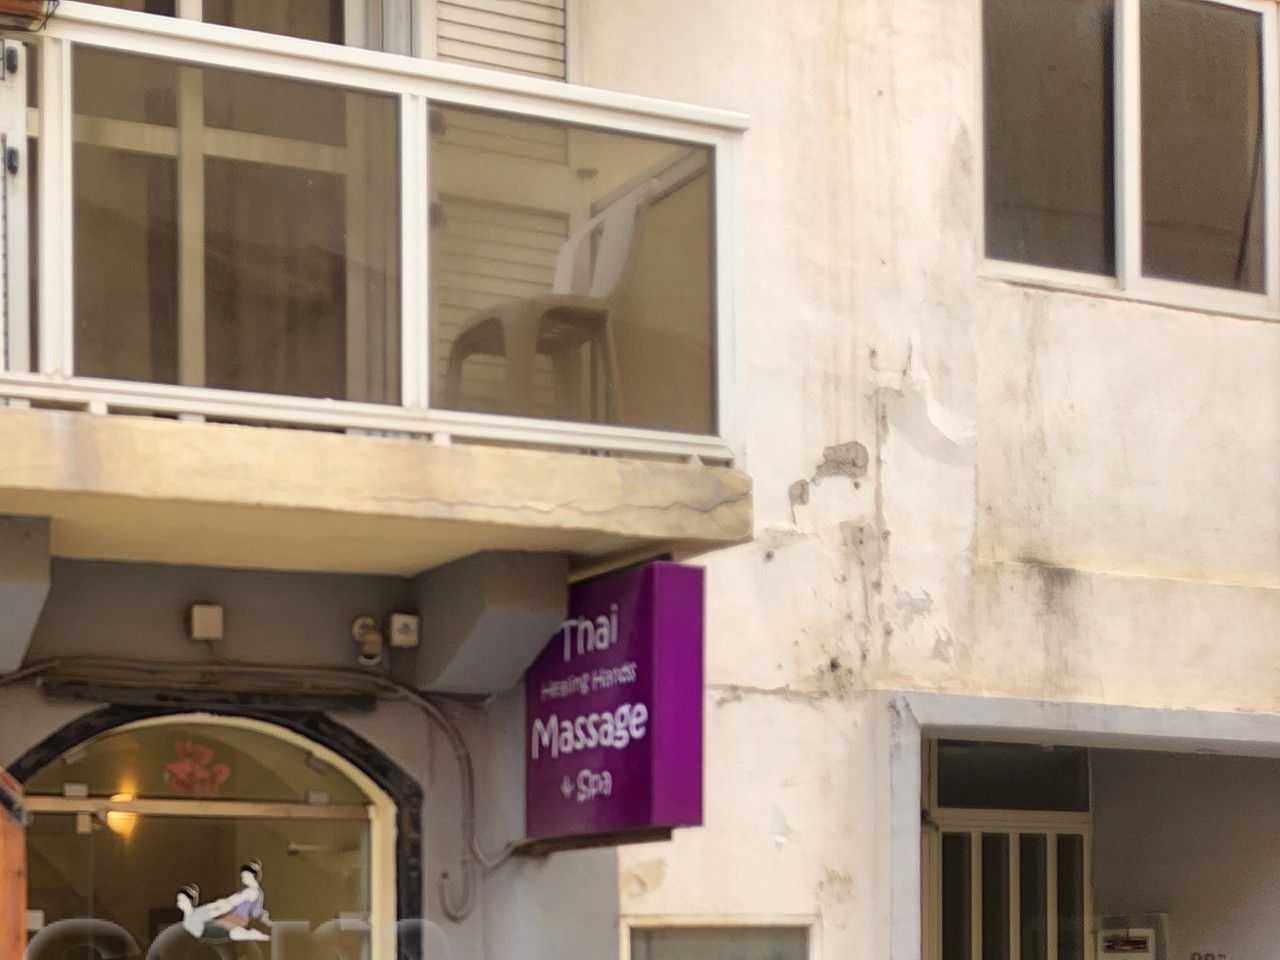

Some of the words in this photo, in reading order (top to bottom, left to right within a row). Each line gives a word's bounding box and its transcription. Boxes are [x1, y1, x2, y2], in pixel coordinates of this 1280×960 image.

[561, 603, 618, 663] Thai
[532, 702, 649, 760] Massage
[576, 768, 613, 803] Spa
